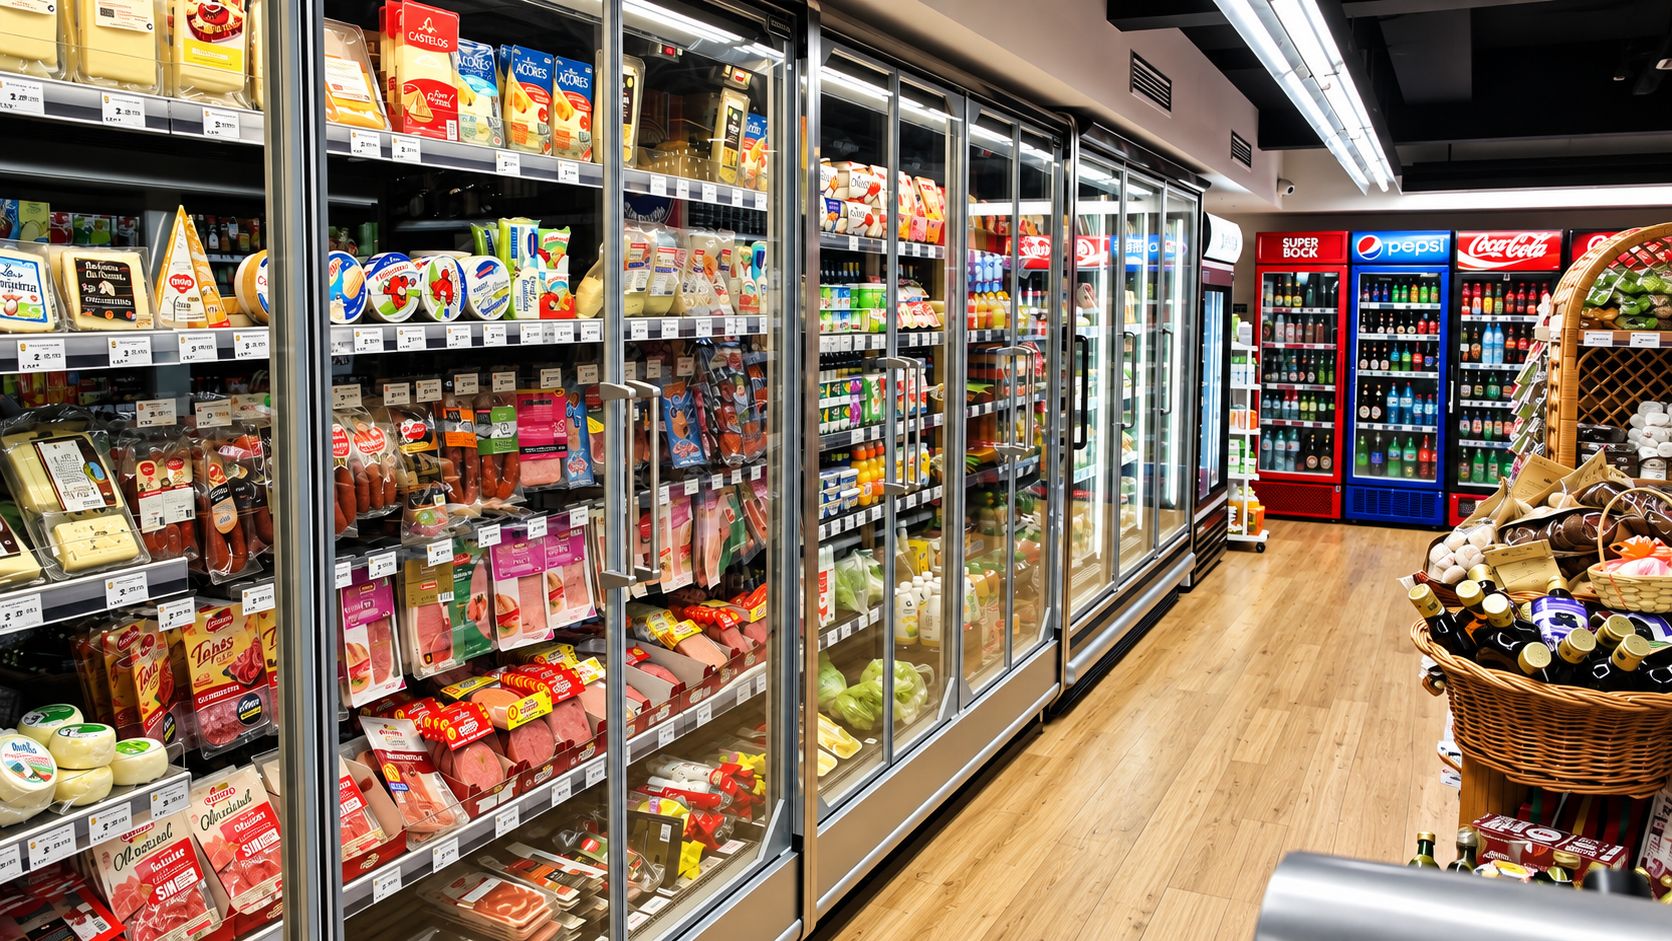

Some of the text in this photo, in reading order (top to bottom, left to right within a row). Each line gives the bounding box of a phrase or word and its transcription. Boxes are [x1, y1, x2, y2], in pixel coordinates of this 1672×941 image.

[408, 31, 449, 49] CASTELOS
[1283, 237, 1319, 248] SUPER
[1384, 238, 1445, 256] pepsi
[1283, 247, 1318, 258] BOCK
